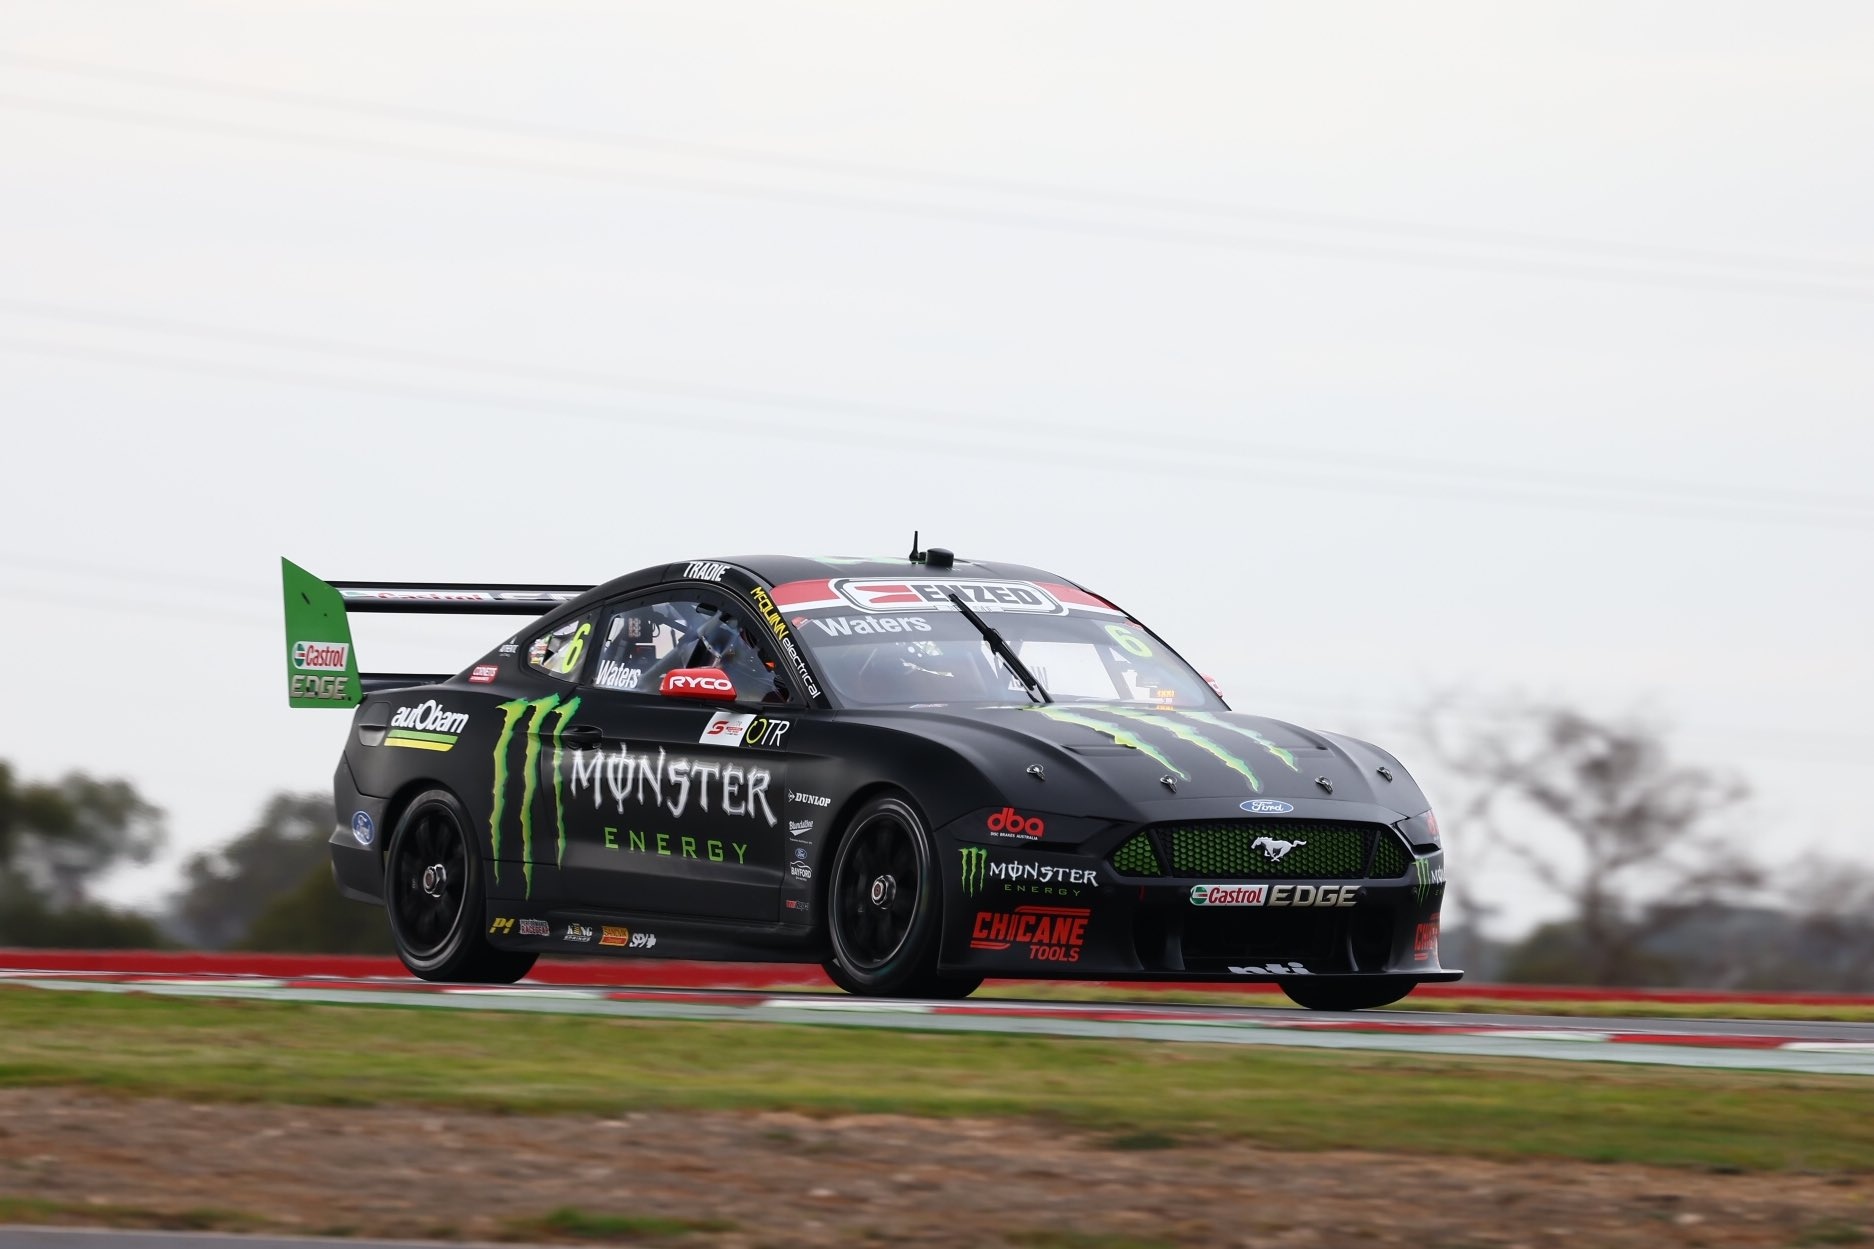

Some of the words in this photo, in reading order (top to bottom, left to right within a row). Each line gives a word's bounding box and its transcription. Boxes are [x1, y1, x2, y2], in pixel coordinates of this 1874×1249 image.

[683, 561, 732, 582] TRADIE
[909, 584, 1042, 606] ENZED
[812, 616, 932, 637] Waters
[562, 623, 591, 674] 6
[1104, 624, 1153, 658] 6
[306, 644, 345, 667] Castrol
[595, 659, 642, 689] Waters
[782, 637, 821, 699] electrical
[290, 674, 349, 699] EDGE
[669, 675, 732, 691] RYCO
[746, 718, 790, 747] OTR
[570, 742, 778, 828] MONSTER
[795, 792, 831, 807] DUNLOP
[1251, 801, 1285, 811] Ford
[987, 807, 1045, 838] dba
[604, 827, 748, 865] ENERGY
[790, 866, 812, 879] BAYFORD
[989, 860, 1100, 887] MONSTER
[1004, 884, 1081, 896] ENERGY
[1208, 886, 1263, 905] Castrol
[1268, 885, 1362, 907] EDGE
[972, 911, 1090, 946] CHICANE
[1029, 945, 1080, 962] TOOLS
